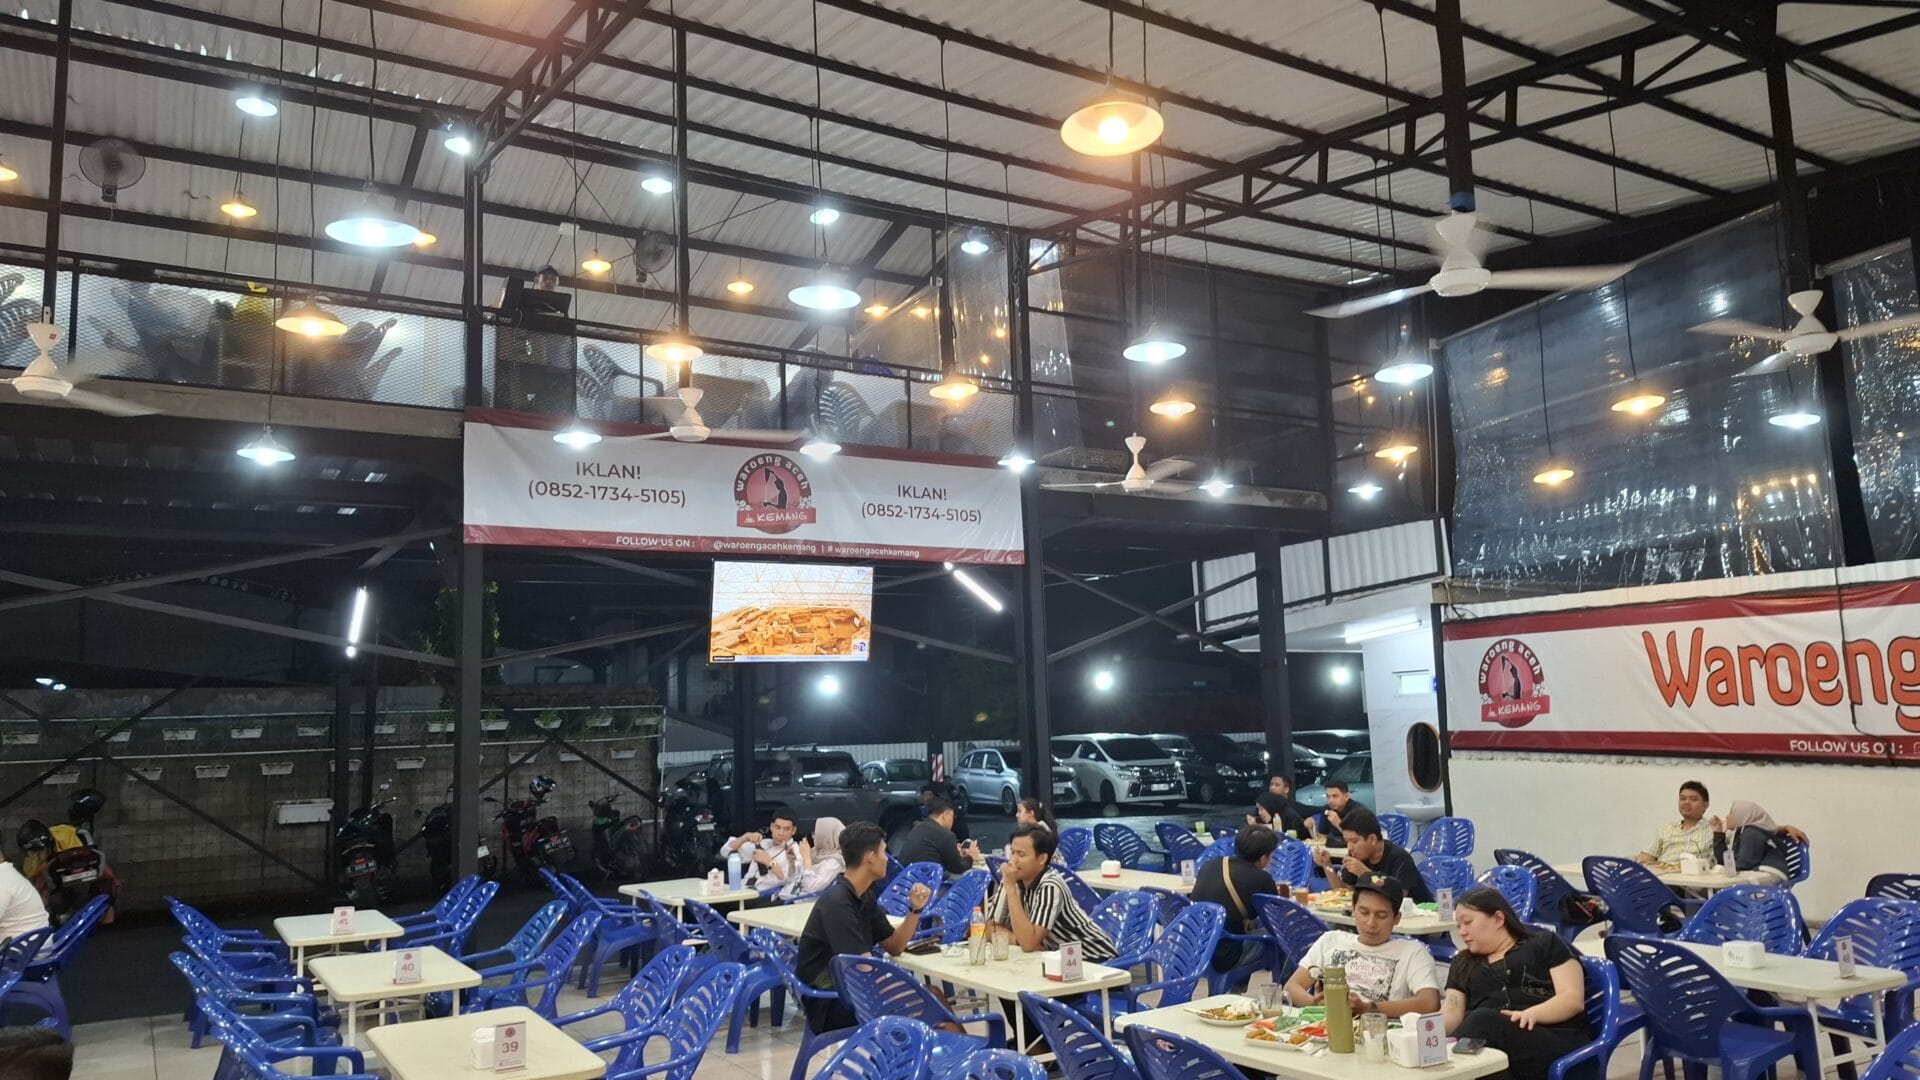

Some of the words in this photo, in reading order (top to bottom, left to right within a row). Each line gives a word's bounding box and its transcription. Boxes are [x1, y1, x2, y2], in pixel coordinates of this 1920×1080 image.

[576, 461, 641, 480] IKLAN!
[736, 455, 782, 492] waroeng
[785, 461, 809, 490] aceh
[528, 480, 686, 508] (0852-1734-5105)
[897, 484, 948, 501] IKLAN!
[757, 511, 808, 523] KEMANG
[861, 502, 982, 525] (0852-1734-5105)
[616, 536, 658, 546] FOLLOW
[661, 537, 674, 547] US
[713, 539, 817, 553] @waroengacehkemang
[834, 546, 920, 558] waroengacehkemang
[1480, 640, 1515, 684] waroeng
[1518, 645, 1542, 675] aceh
[1641, 627, 1920, 733] Waroeng
[1497, 700, 1542, 715] KEMANG
[1789, 739, 1847, 753] FOLLOW
[1850, 741, 1870, 754] US
[401, 962, 415, 972] 40
[1066, 958, 1077, 967] 44
[502, 1040, 519, 1054] 39
[1425, 1035, 1439, 1048] 43
